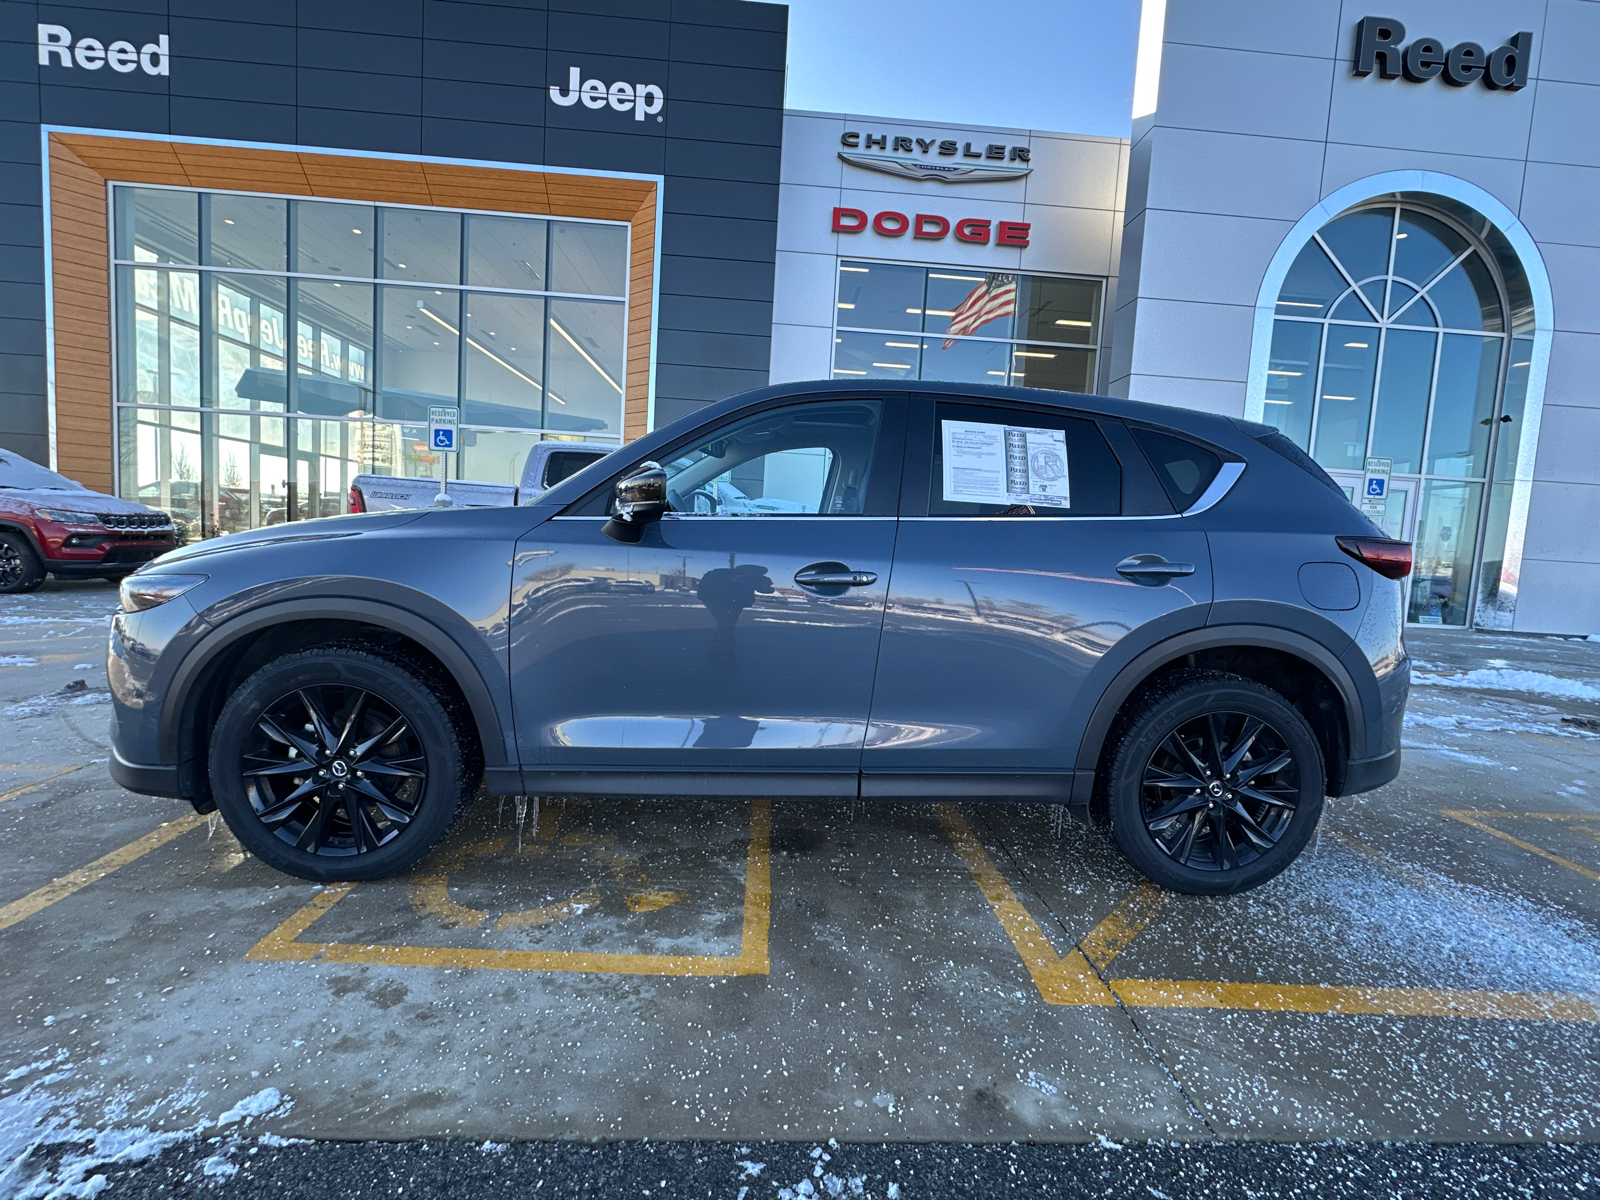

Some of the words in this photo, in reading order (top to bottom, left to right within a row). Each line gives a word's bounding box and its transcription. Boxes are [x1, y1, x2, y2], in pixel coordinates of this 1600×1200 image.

[37, 23, 170, 76] Reed
[1353, 16, 1534, 92] Reed
[840, 131, 1032, 161] CHRYSLER
[831, 207, 1031, 247] DODGE
[431, 409, 456, 418] RESERVED
[431, 417, 457, 426] PARKING
[370, 491, 411, 500] WARLOCK
